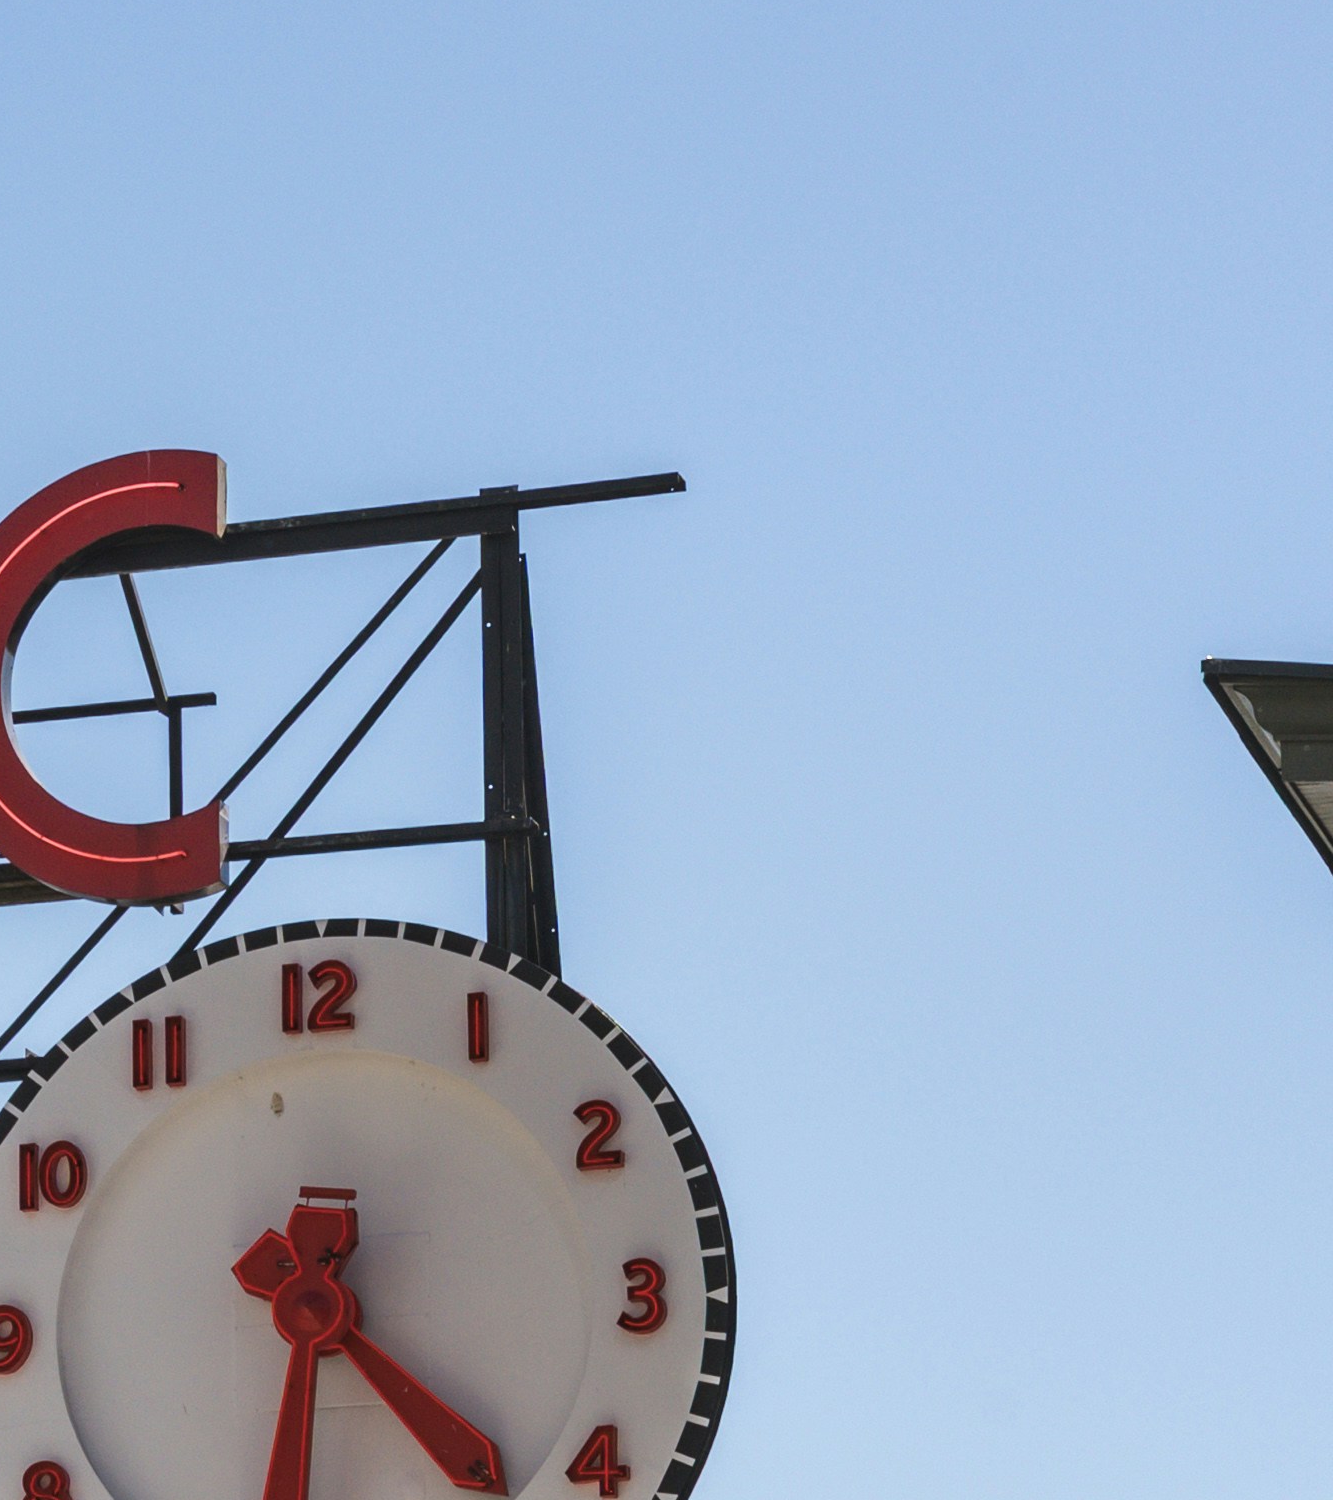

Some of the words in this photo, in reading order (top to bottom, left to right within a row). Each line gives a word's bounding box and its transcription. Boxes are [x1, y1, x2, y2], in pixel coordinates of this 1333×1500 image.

[281, 959, 357, 1034] 12
[466, 991, 490, 1063] 1
[132, 1014, 186, 1090] 11
[572, 1100, 625, 1169] 2
[18, 1140, 89, 1212] 10
[616, 1257, 667, 1335] 3
[565, 1424, 630, 1498] 4
